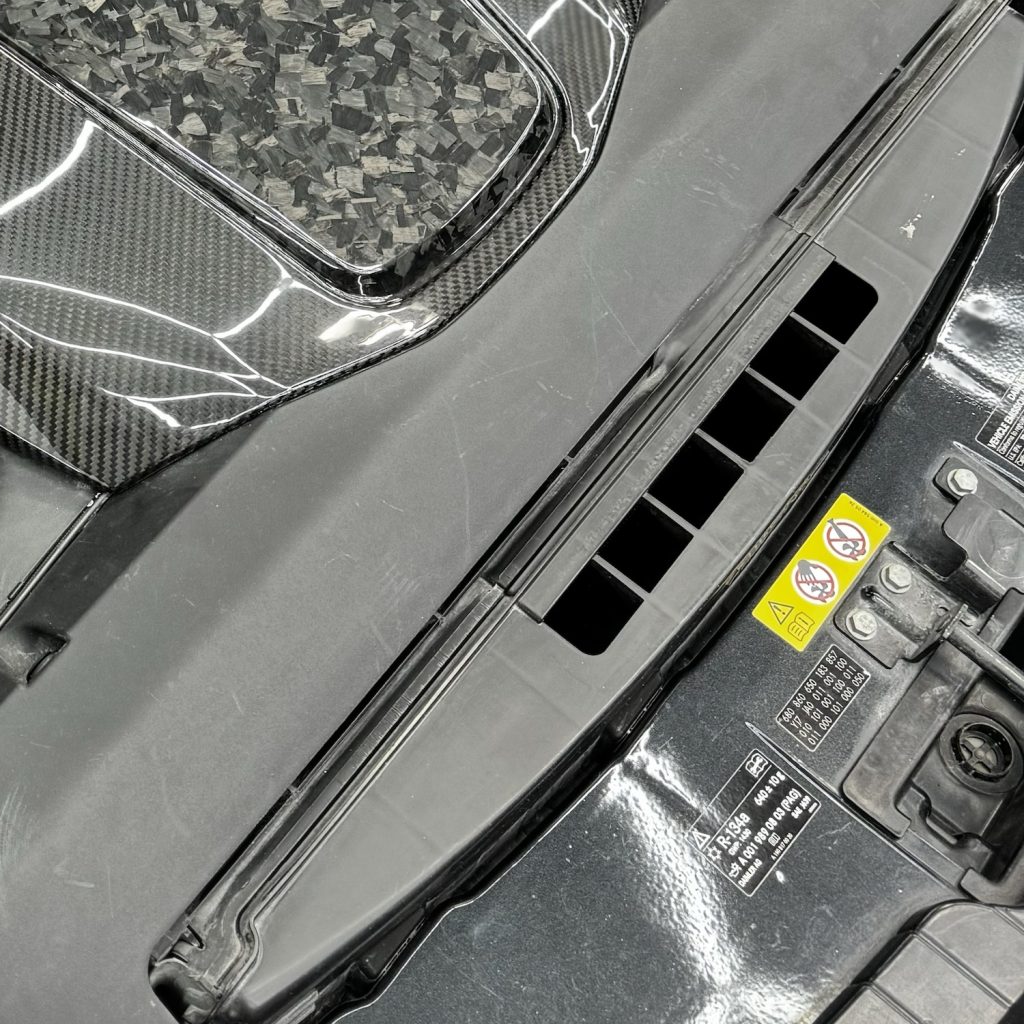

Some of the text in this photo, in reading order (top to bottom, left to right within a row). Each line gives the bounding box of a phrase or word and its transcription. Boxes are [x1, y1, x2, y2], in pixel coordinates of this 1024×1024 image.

[986, 421, 1010, 449] VEHICLE
[780, 649, 838, 722] 680 860 650 183 857
[812, 686, 826, 701] 011
[823, 672, 836, 686] 001
[834, 657, 847, 671] 100
[798, 665, 856, 738] 010 101 001 100 011
[807, 672, 865, 745] 011 000 101 000 050
[716, 812, 751, 849] R-134a
[738, 787, 802, 866] A 001 989 08 03 (PAG)
[791, 806, 803, 819] SAE
[737, 858, 763, 887] DAIMLER AG
